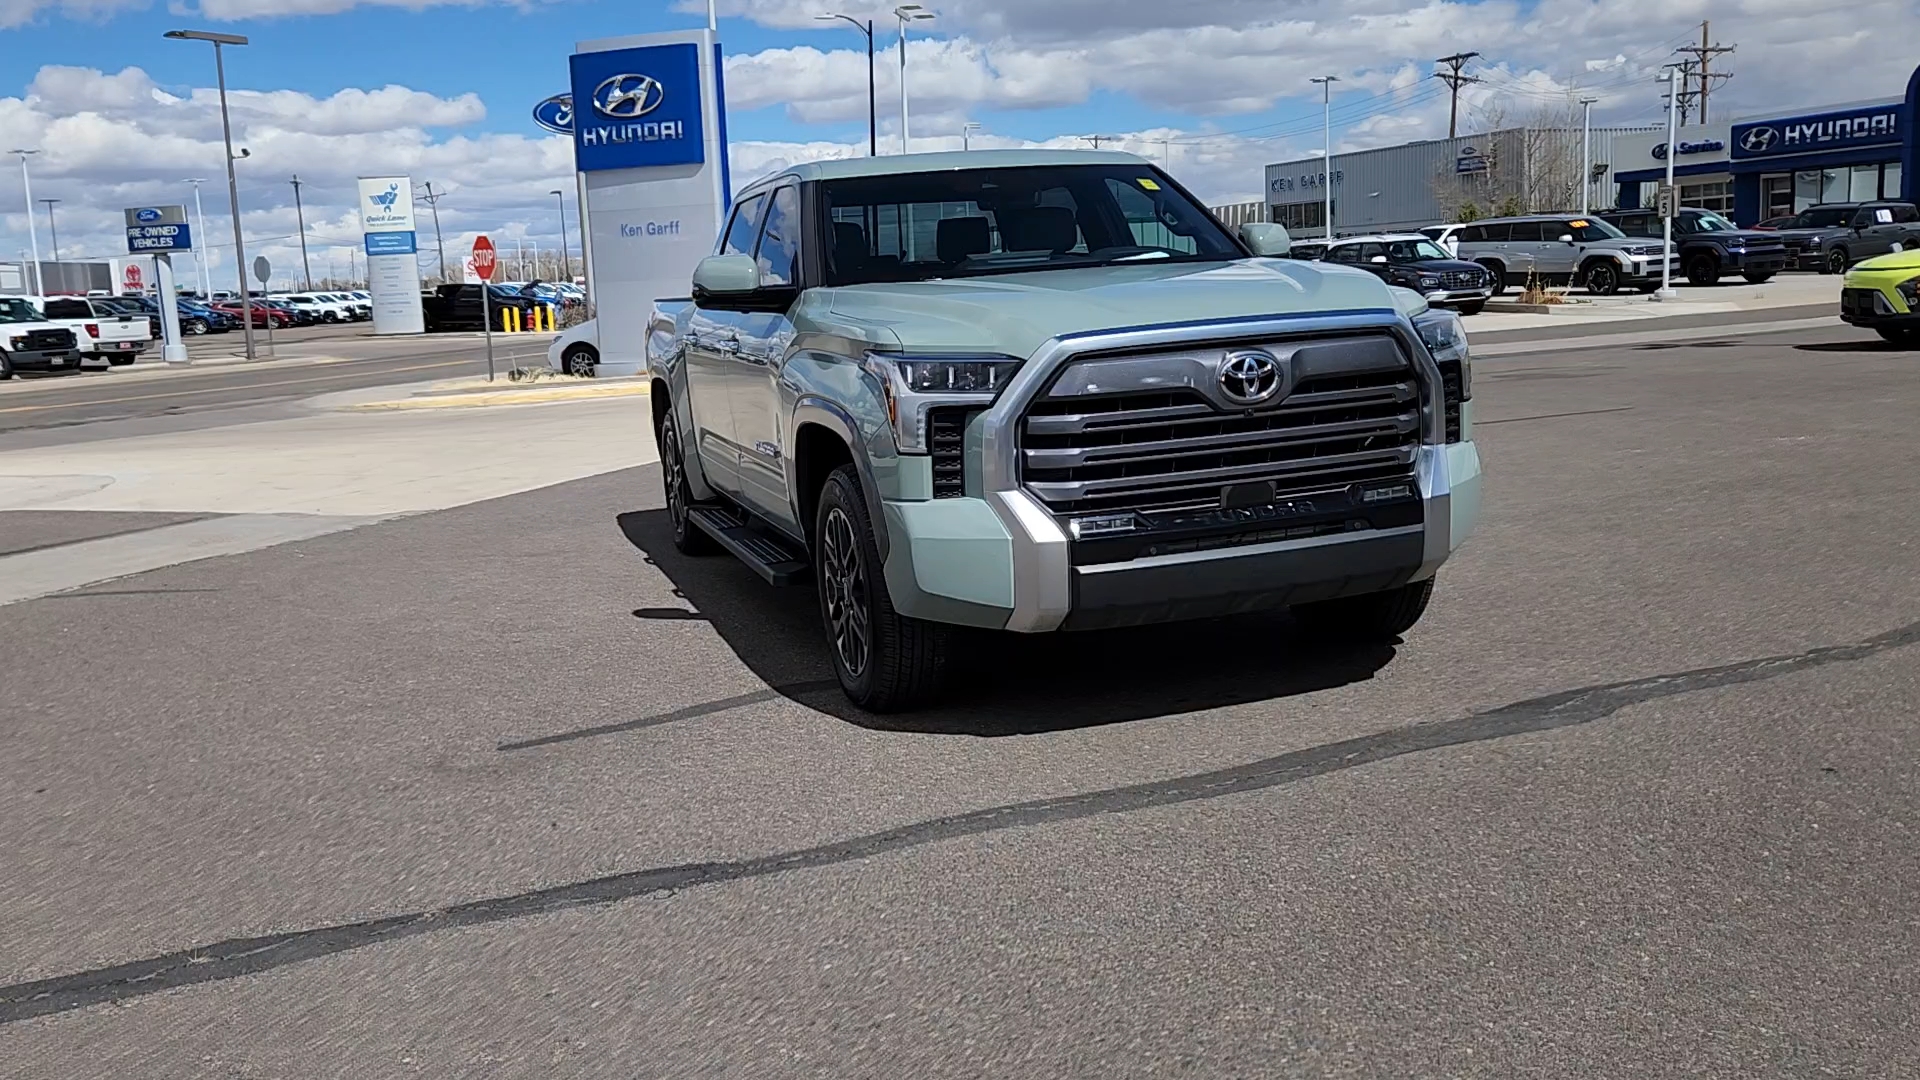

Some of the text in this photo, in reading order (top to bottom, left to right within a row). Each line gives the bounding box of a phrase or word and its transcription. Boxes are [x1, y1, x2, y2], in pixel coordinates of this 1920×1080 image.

[583, 120, 683, 147] HYUNDAI
[1785, 114, 1896, 145] HYUNDAI
[1271, 171, 1344, 191] KEN GARFF
[140, 210, 156, 220] Ford
[1661, 202, 1668, 214] 5
[366, 215, 386, 223] Quick
[128, 226, 179, 238] PRE-OWNED
[620, 220, 680, 237] Ken Garff
[133, 237, 174, 248] VEHICLES
[473, 249, 494, 267] STOP
